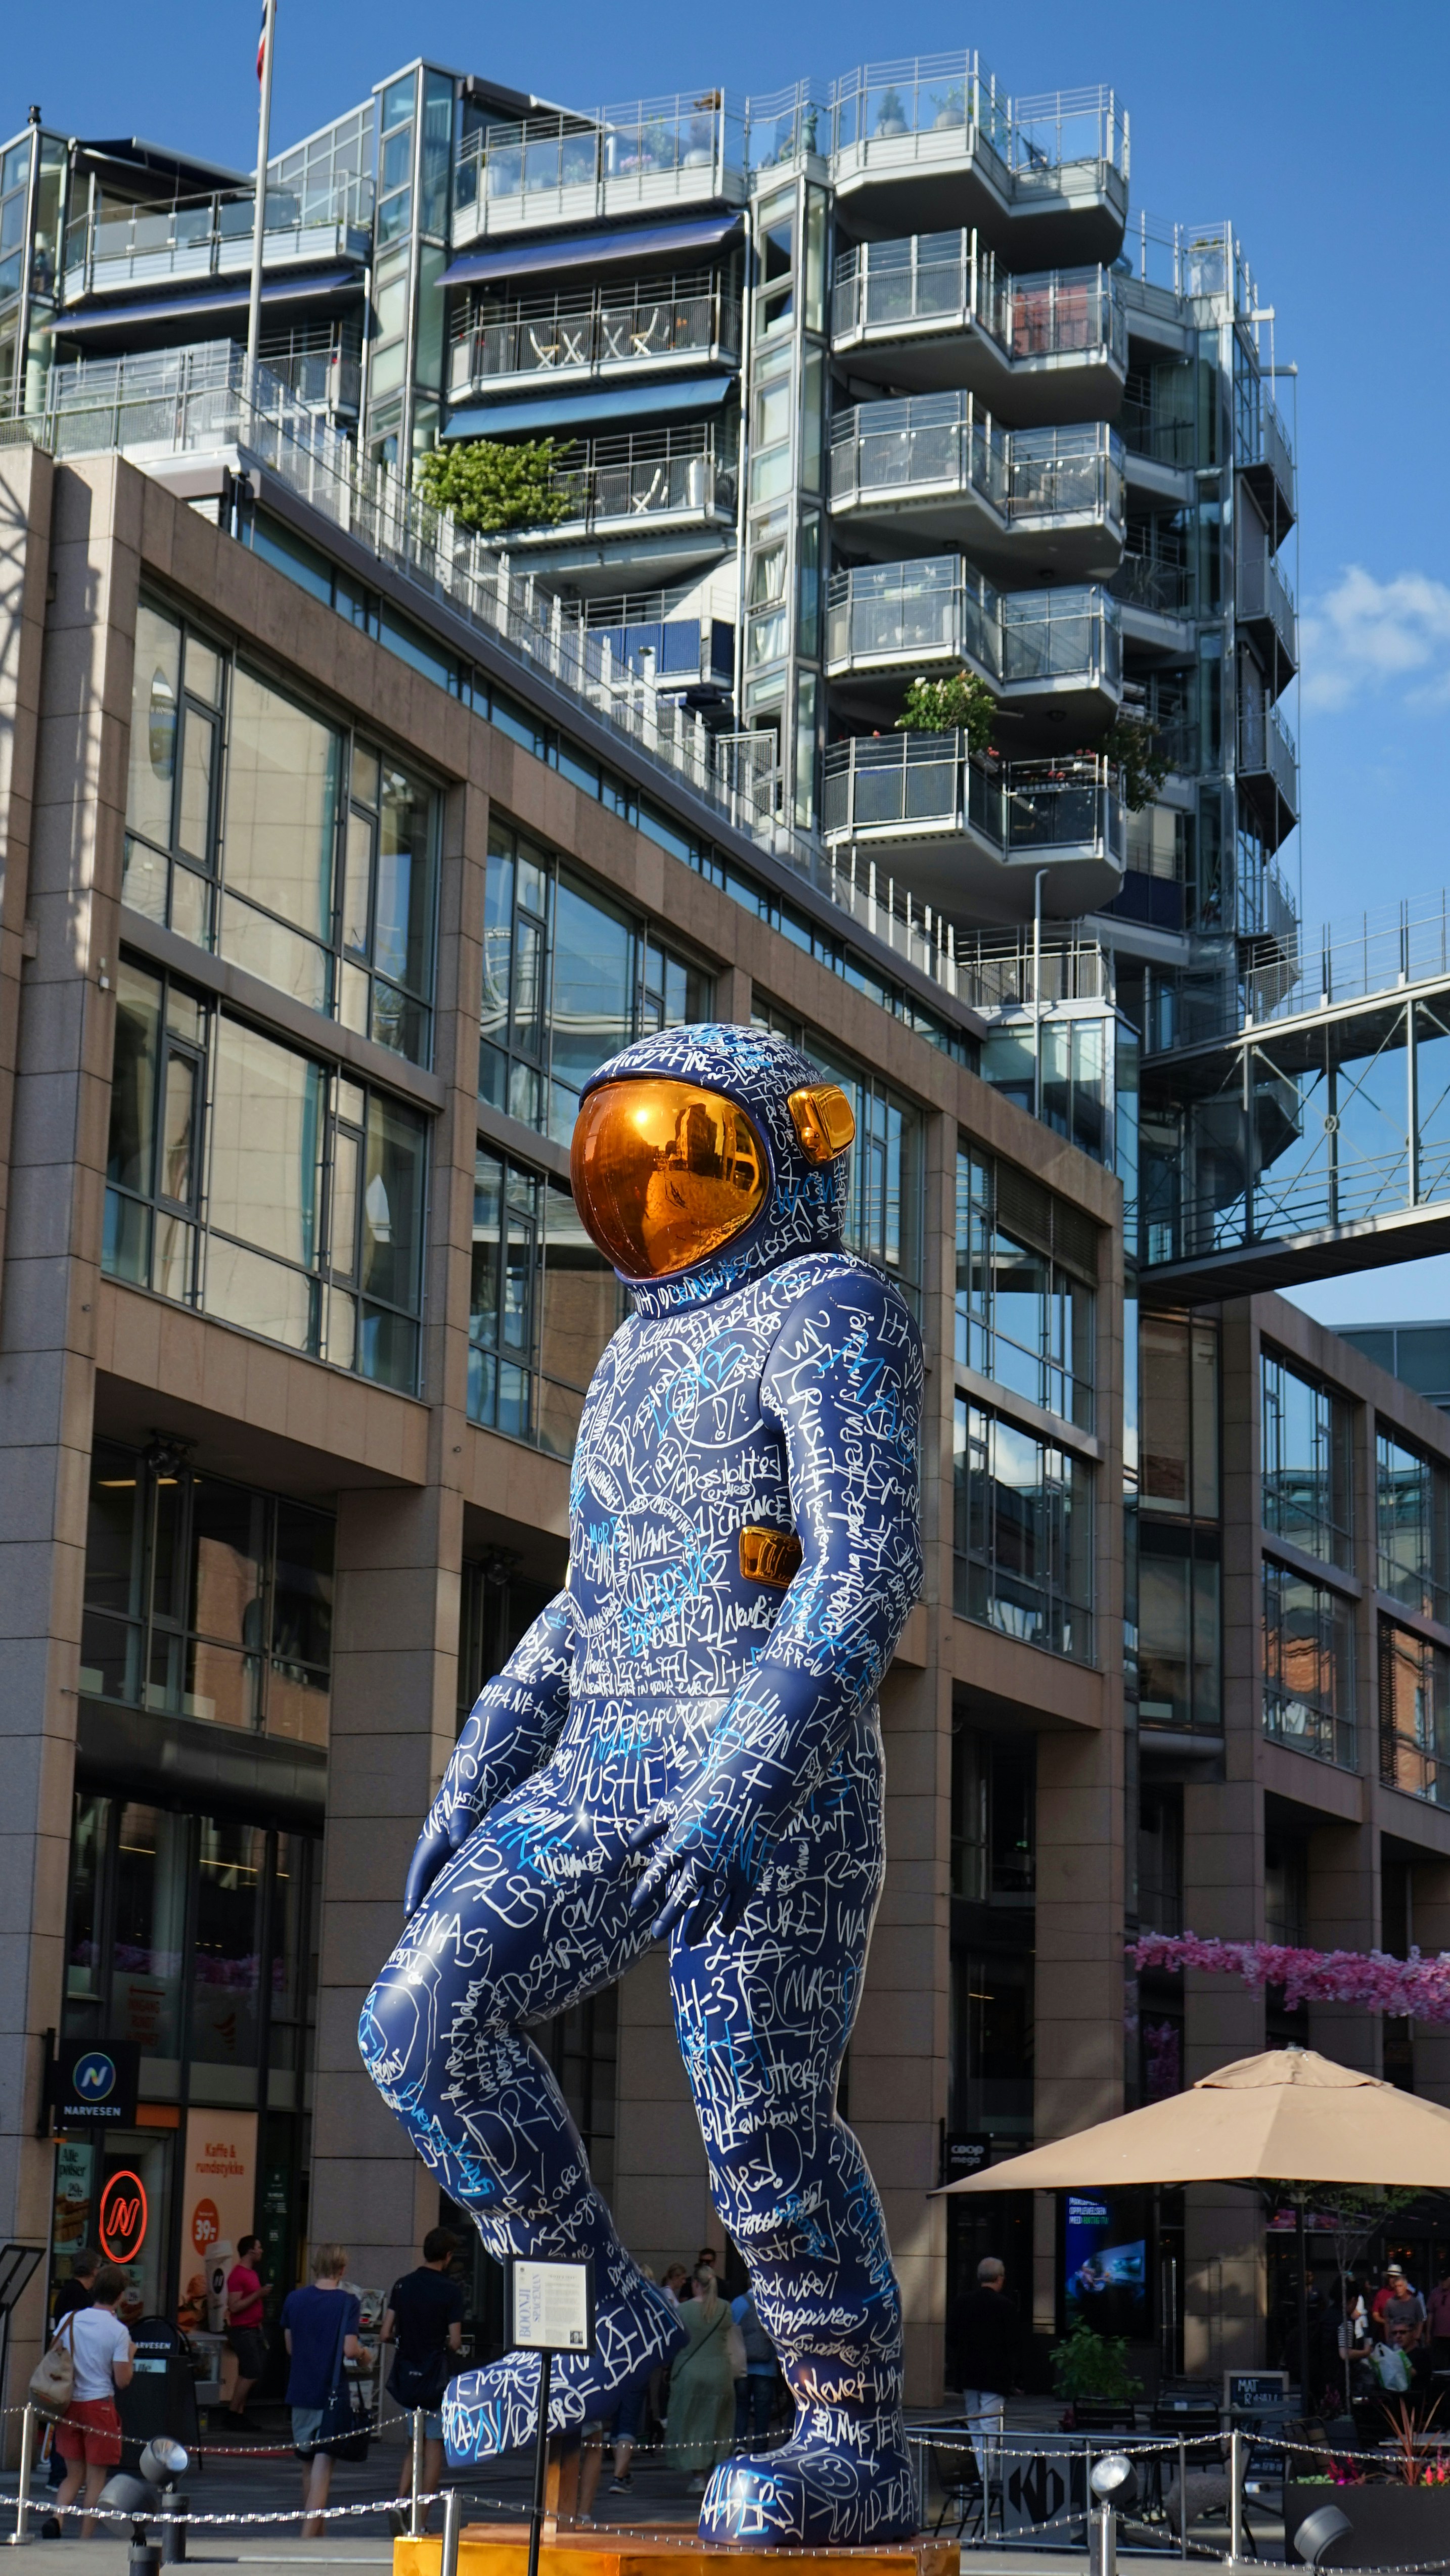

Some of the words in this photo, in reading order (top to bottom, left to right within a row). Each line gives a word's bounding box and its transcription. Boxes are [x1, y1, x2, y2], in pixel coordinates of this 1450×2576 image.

[776, 1165, 841, 1214] WOW
[592, 1725, 651, 1761] WANT
[568, 1745, 663, 1815] HUSTLE
[64, 2106, 121, 2117] NARVESEN
[62, 2149, 78, 2163] Alle
[205, 2143, 228, 2158] Kaffe
[229, 2144, 236, 2158] &
[950, 2156, 981, 2167] mega
[196, 2161, 244, 2178] rundstykke
[1069, 2216, 1082, 2225] MED
[519, 2288, 531, 2338] BOONJI
[135, 2341, 171, 2350] ARVESEN
[1238, 2379, 1260, 2393] MAT
